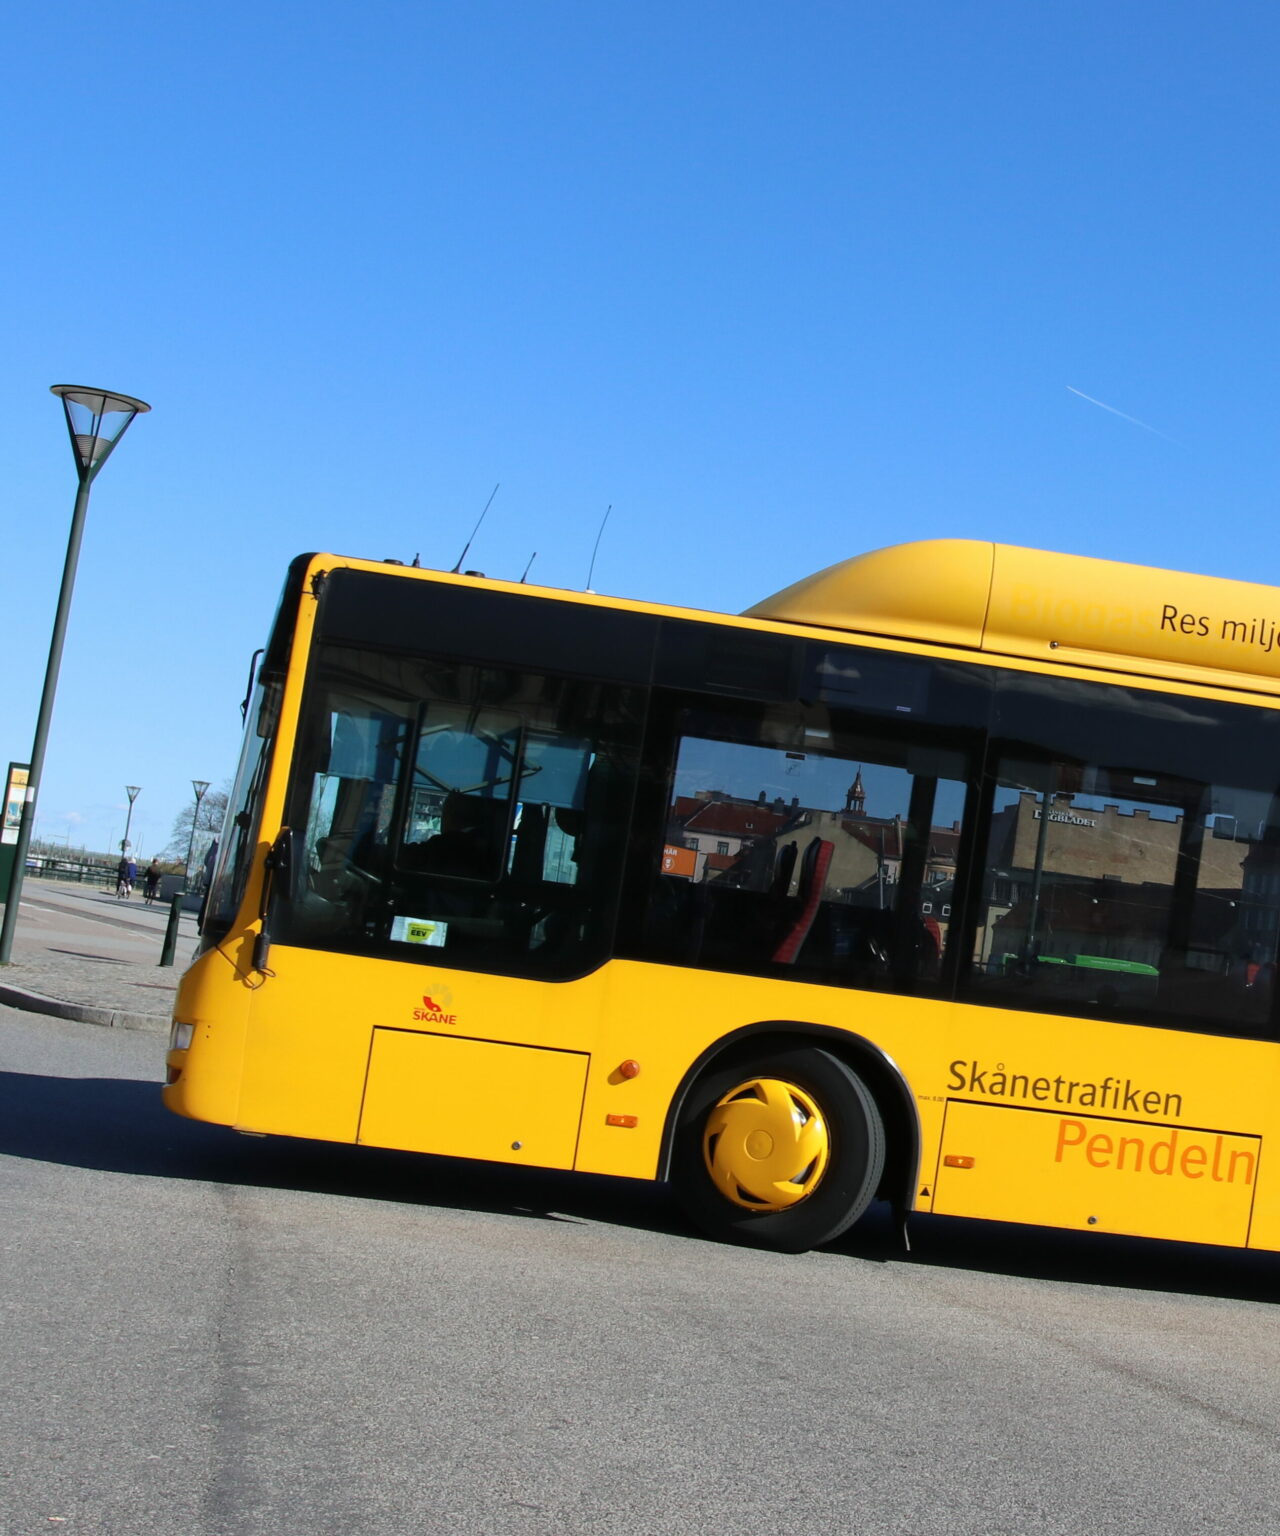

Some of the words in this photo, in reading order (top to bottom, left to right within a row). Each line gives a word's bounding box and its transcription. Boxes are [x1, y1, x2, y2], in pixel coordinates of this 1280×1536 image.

[1160, 604, 1210, 637] Res
[1033, 809, 1097, 827] DGBLADET
[410, 929, 427, 938] EEV
[947, 1059, 1183, 1118] Skånetrafiken
[1054, 1118, 1256, 1186] Pendeln
